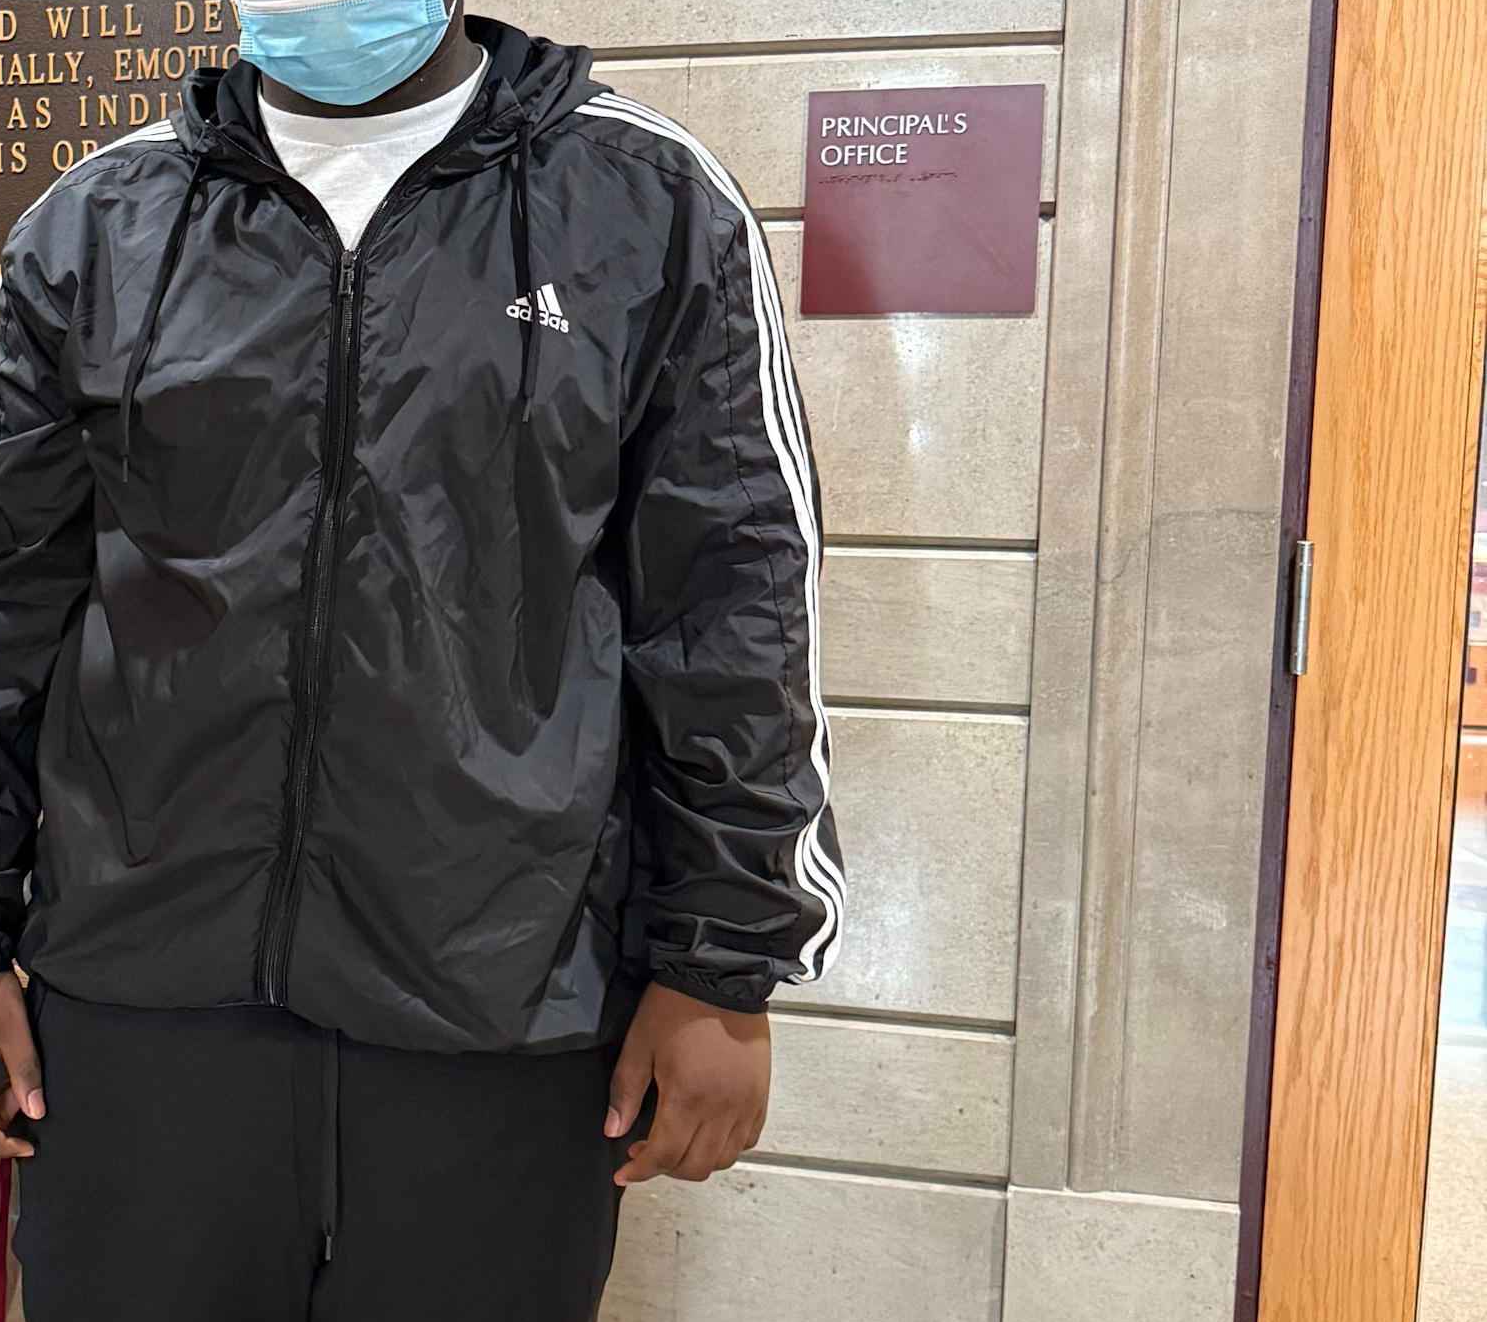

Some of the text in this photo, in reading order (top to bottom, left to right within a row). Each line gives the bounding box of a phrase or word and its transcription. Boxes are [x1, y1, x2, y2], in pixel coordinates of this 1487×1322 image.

[46, 3, 142, 39] WILL
[114, 44, 240, 82] EMOTIO
[7, 97, 52, 130] AS
[79, 91, 182, 127] INDI
[821, 113, 968, 138] PRINCIPAL'S
[820, 143, 908, 167] OFFICE
[506, 304, 570, 334] addas
